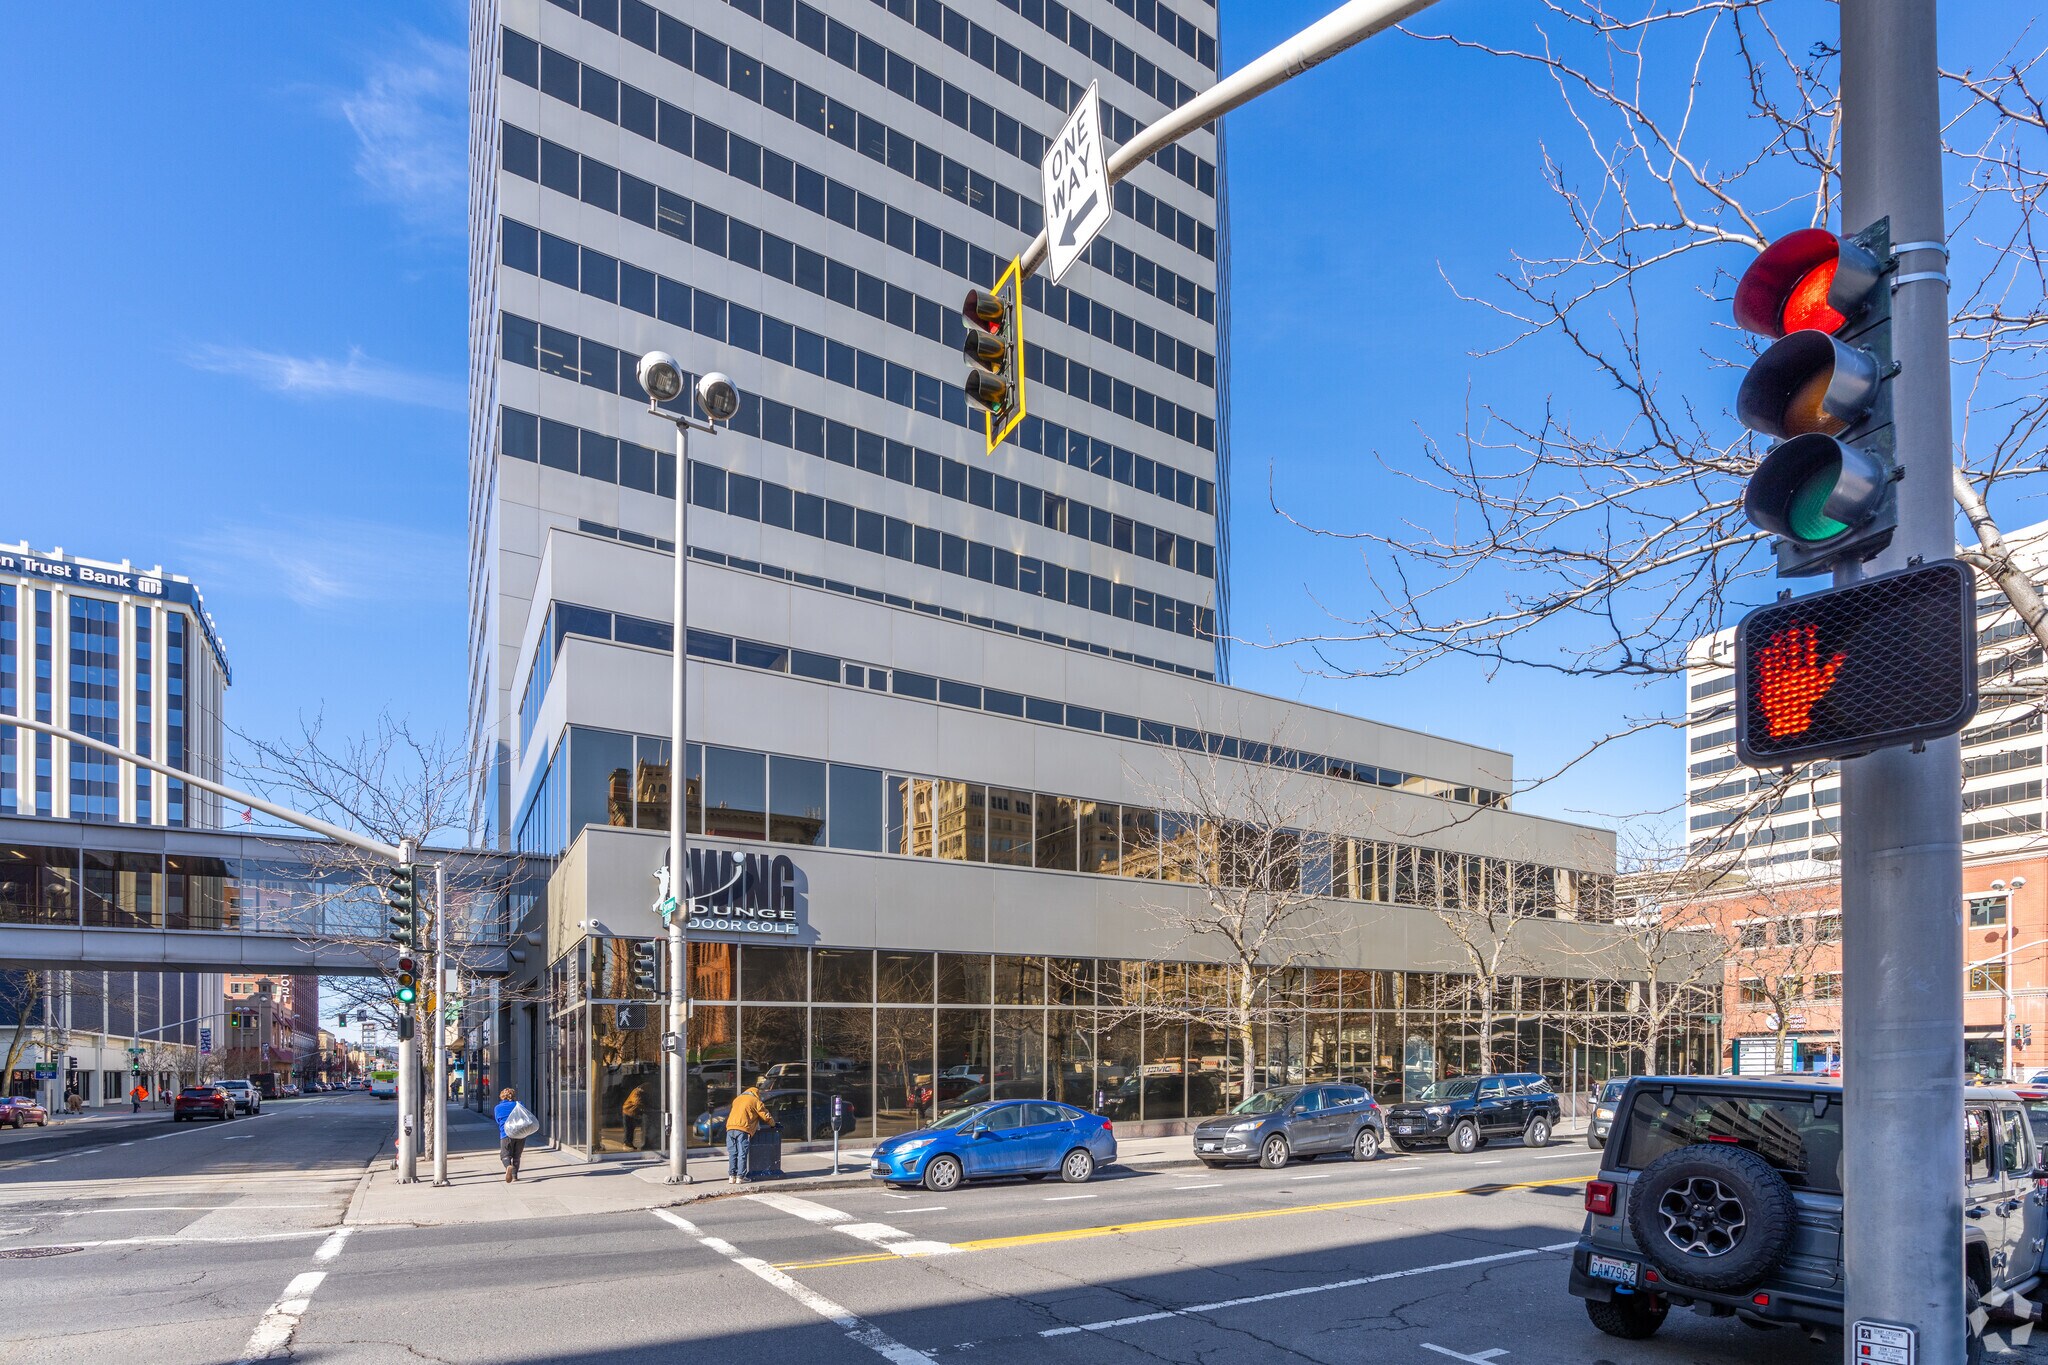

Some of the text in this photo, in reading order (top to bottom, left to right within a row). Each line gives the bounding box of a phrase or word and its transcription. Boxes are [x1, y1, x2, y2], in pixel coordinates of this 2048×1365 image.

[1052, 109, 1088, 181] ONE
[1052, 142, 1090, 219] WAY
[0, 555, 131, 588] n Trust Bank
[687, 917, 796, 933] DOOR GOLF
[690, 904, 797, 920] OUNGE
[1591, 1262, 1636, 1283] CAW7962
